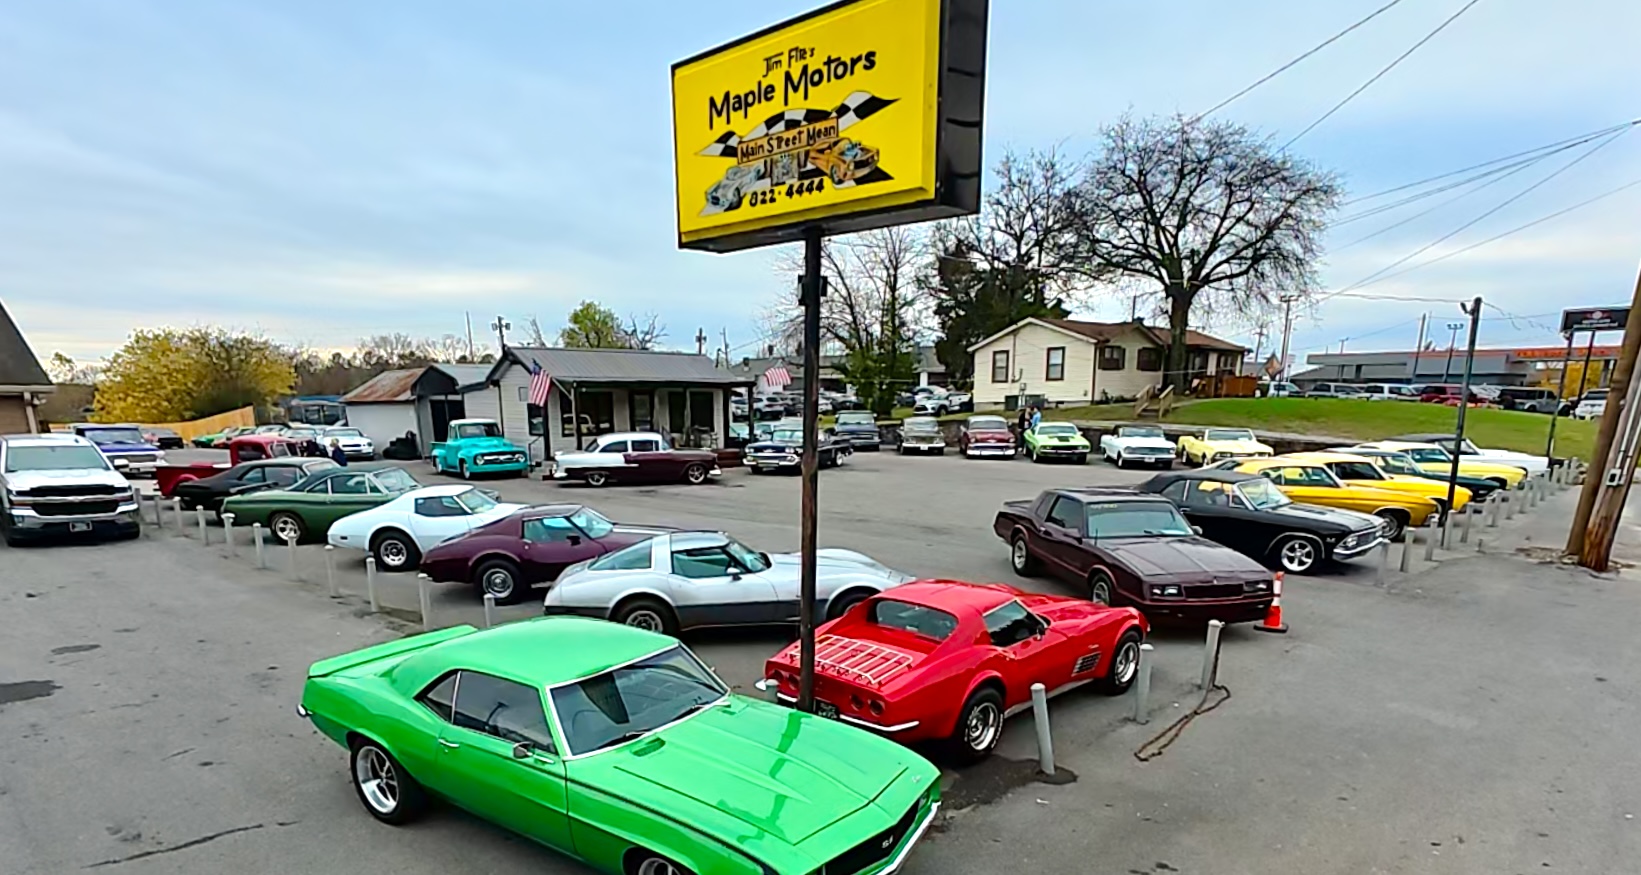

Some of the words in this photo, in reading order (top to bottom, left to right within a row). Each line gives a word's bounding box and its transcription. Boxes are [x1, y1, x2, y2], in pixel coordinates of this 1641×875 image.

[708, 80, 776, 131] Maple
[783, 51, 877, 106] Motors
[741, 143, 764, 161] Main
[807, 125, 836, 146] Mean
